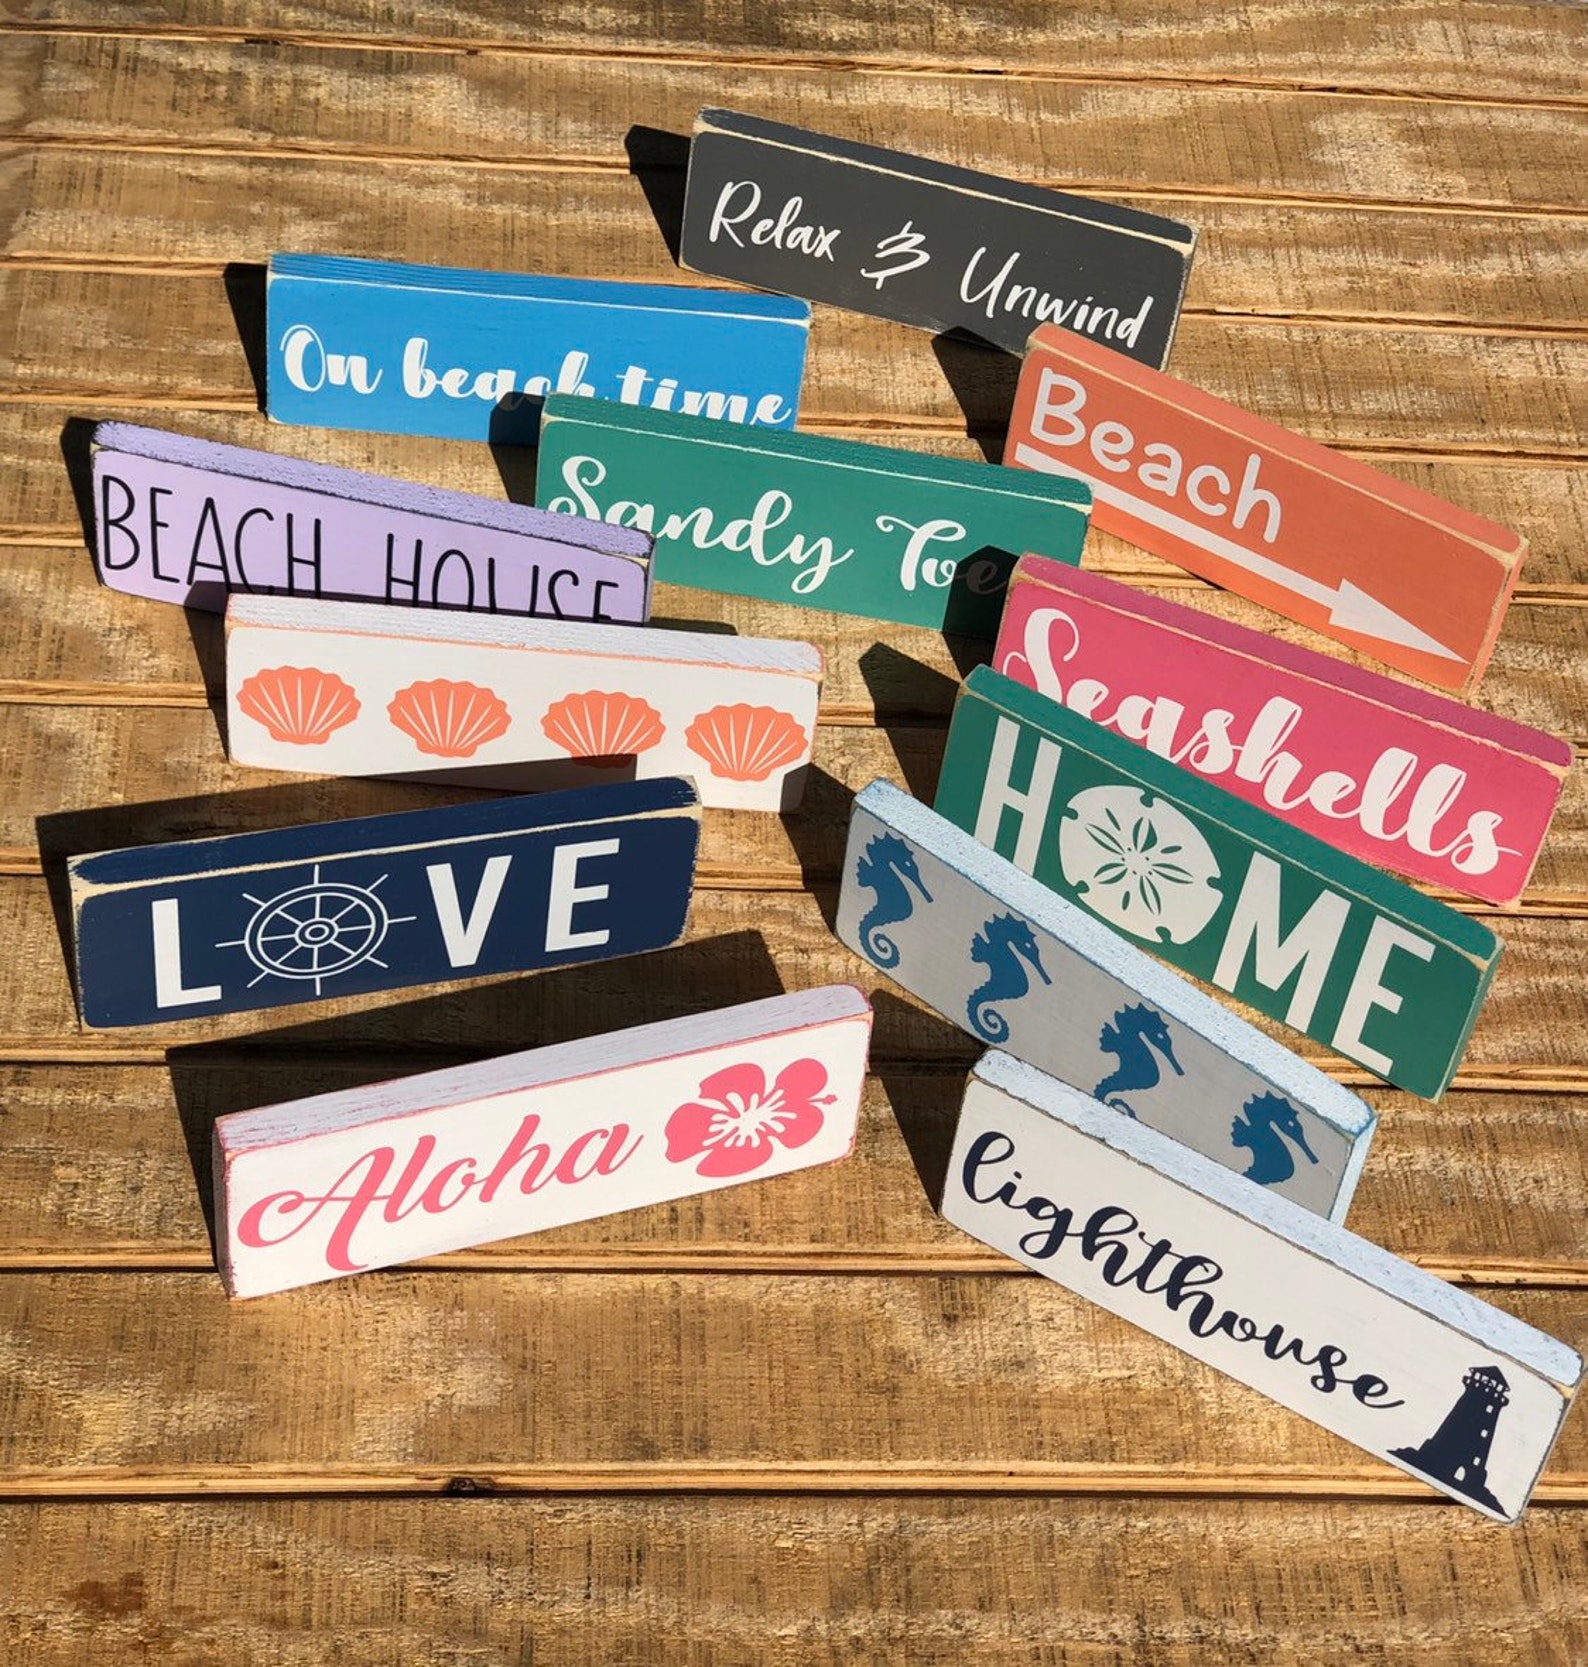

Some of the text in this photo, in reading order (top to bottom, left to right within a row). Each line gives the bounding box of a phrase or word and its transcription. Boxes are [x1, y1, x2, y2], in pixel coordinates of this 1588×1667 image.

[709, 181, 842, 262] Relax
[960, 246, 1155, 349] Unwind
[280, 324, 793, 425] On beach time
[1029, 367, 1282, 543] Beach
[102, 475, 321, 598] BEACH
[548, 455, 1008, 595] Sandy Toe
[1003, 608, 1523, 875] Seashells
[237, 1114, 643, 1271] Aloha
[963, 1131, 1405, 1409] lighthouse
